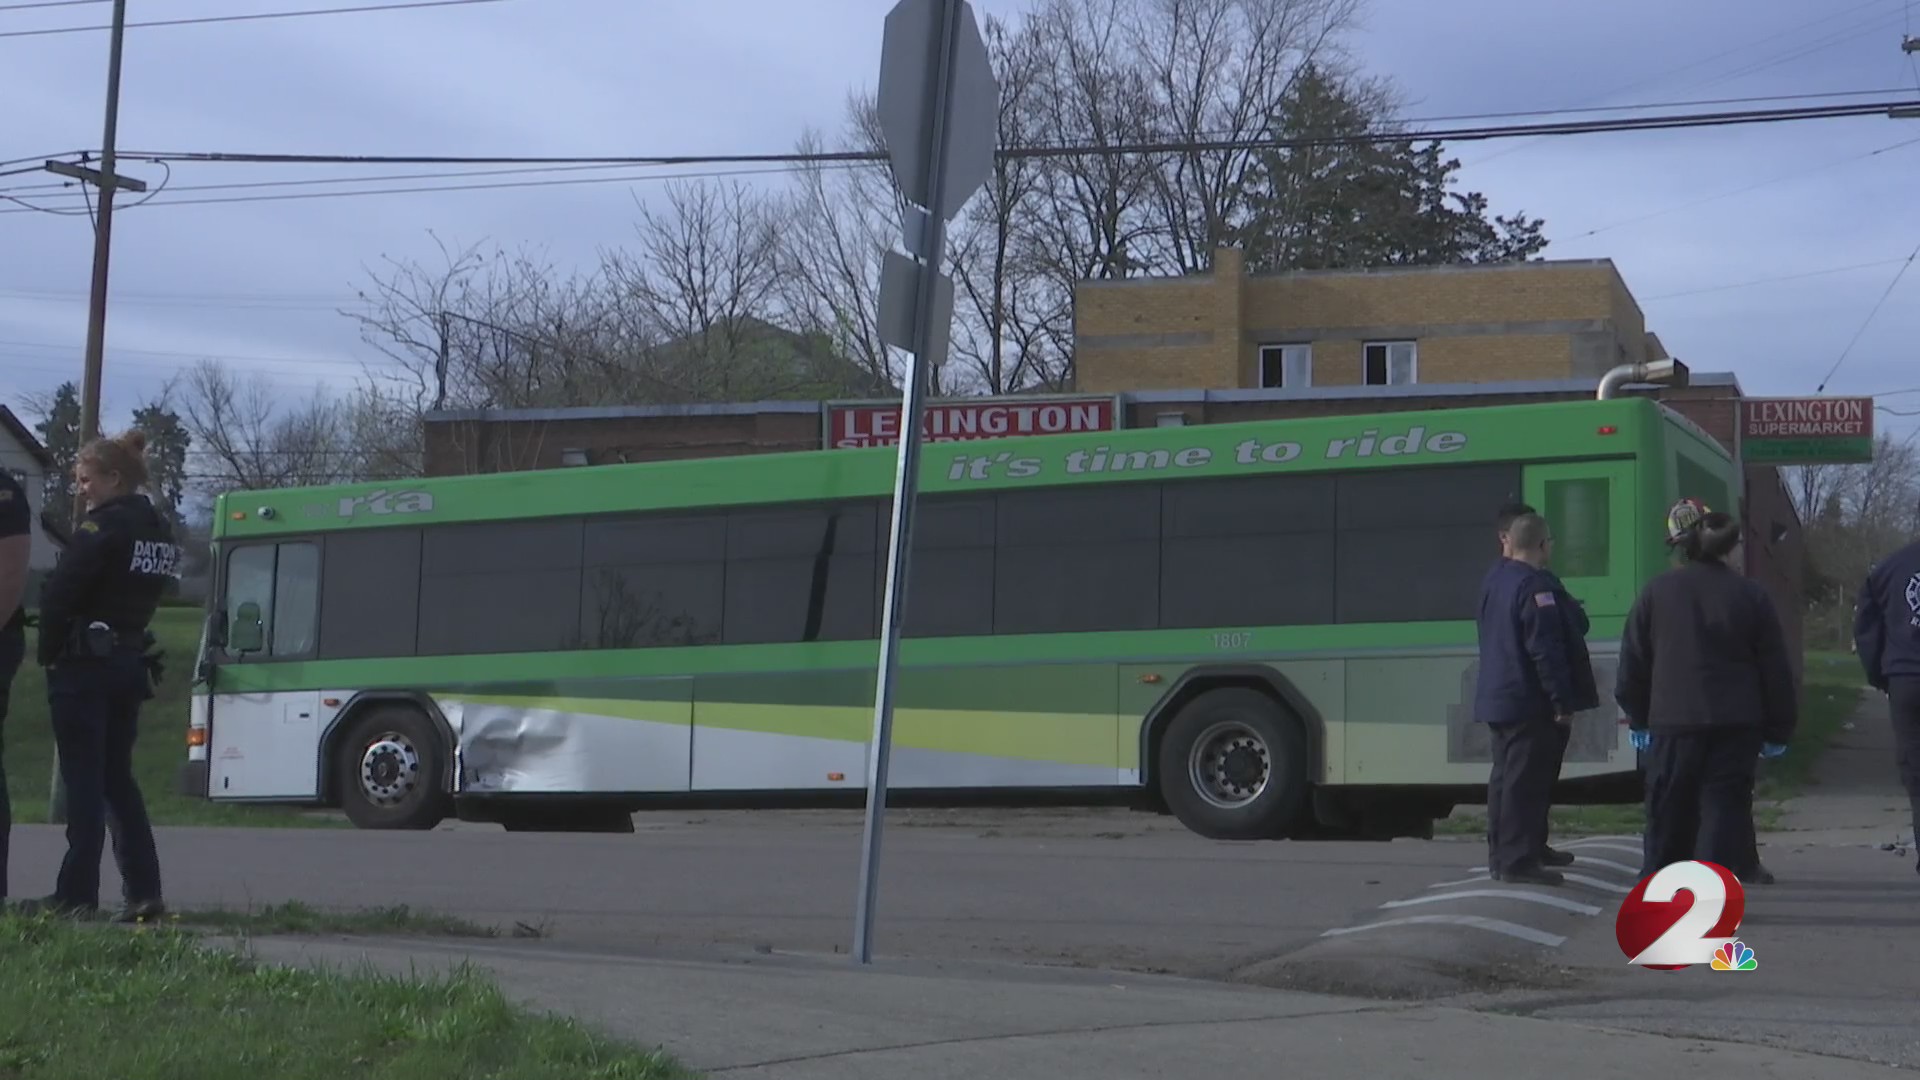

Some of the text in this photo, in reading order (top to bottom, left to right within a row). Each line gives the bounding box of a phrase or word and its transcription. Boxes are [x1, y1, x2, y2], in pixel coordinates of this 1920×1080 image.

[1749, 400, 1863, 421] LEXINGTON
[1748, 421, 1863, 435] SUPERMARKET
[948, 426, 1467, 481] it's time to ride
[133, 540, 177, 559] DAYTON
[129, 556, 178, 576] POLICE
[1213, 632, 1251, 648] 1807
